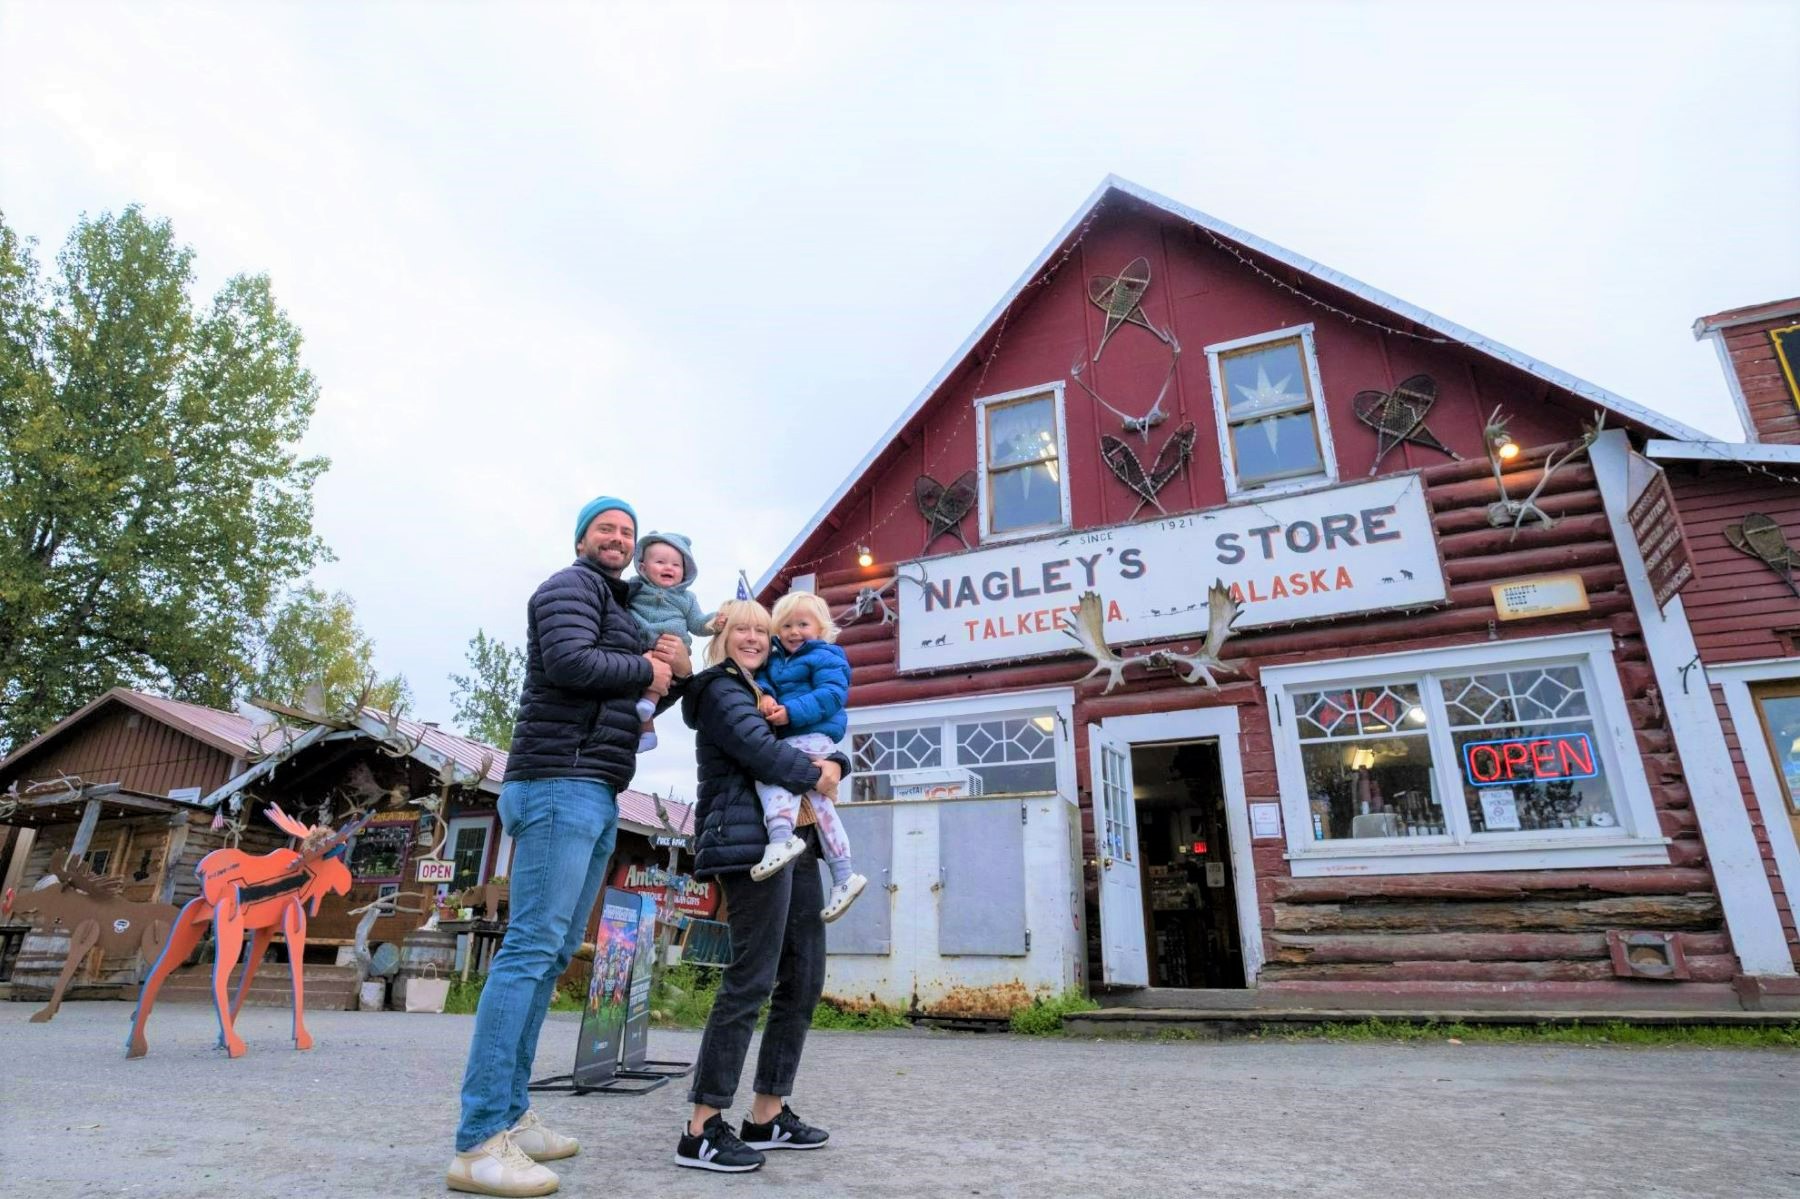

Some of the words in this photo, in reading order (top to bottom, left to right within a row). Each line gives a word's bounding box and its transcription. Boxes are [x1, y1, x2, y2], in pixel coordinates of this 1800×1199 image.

[1080, 531, 1113, 544] SINCE
[1161, 518, 1193, 531] 1921
[924, 546, 1146, 612] NAGLEY'S
[1215, 505, 1402, 565] STORE
[1229, 566, 1354, 604] ALASKA
[1470, 737, 1594, 781] OPEN
[422, 864, 452, 879] OPEN
